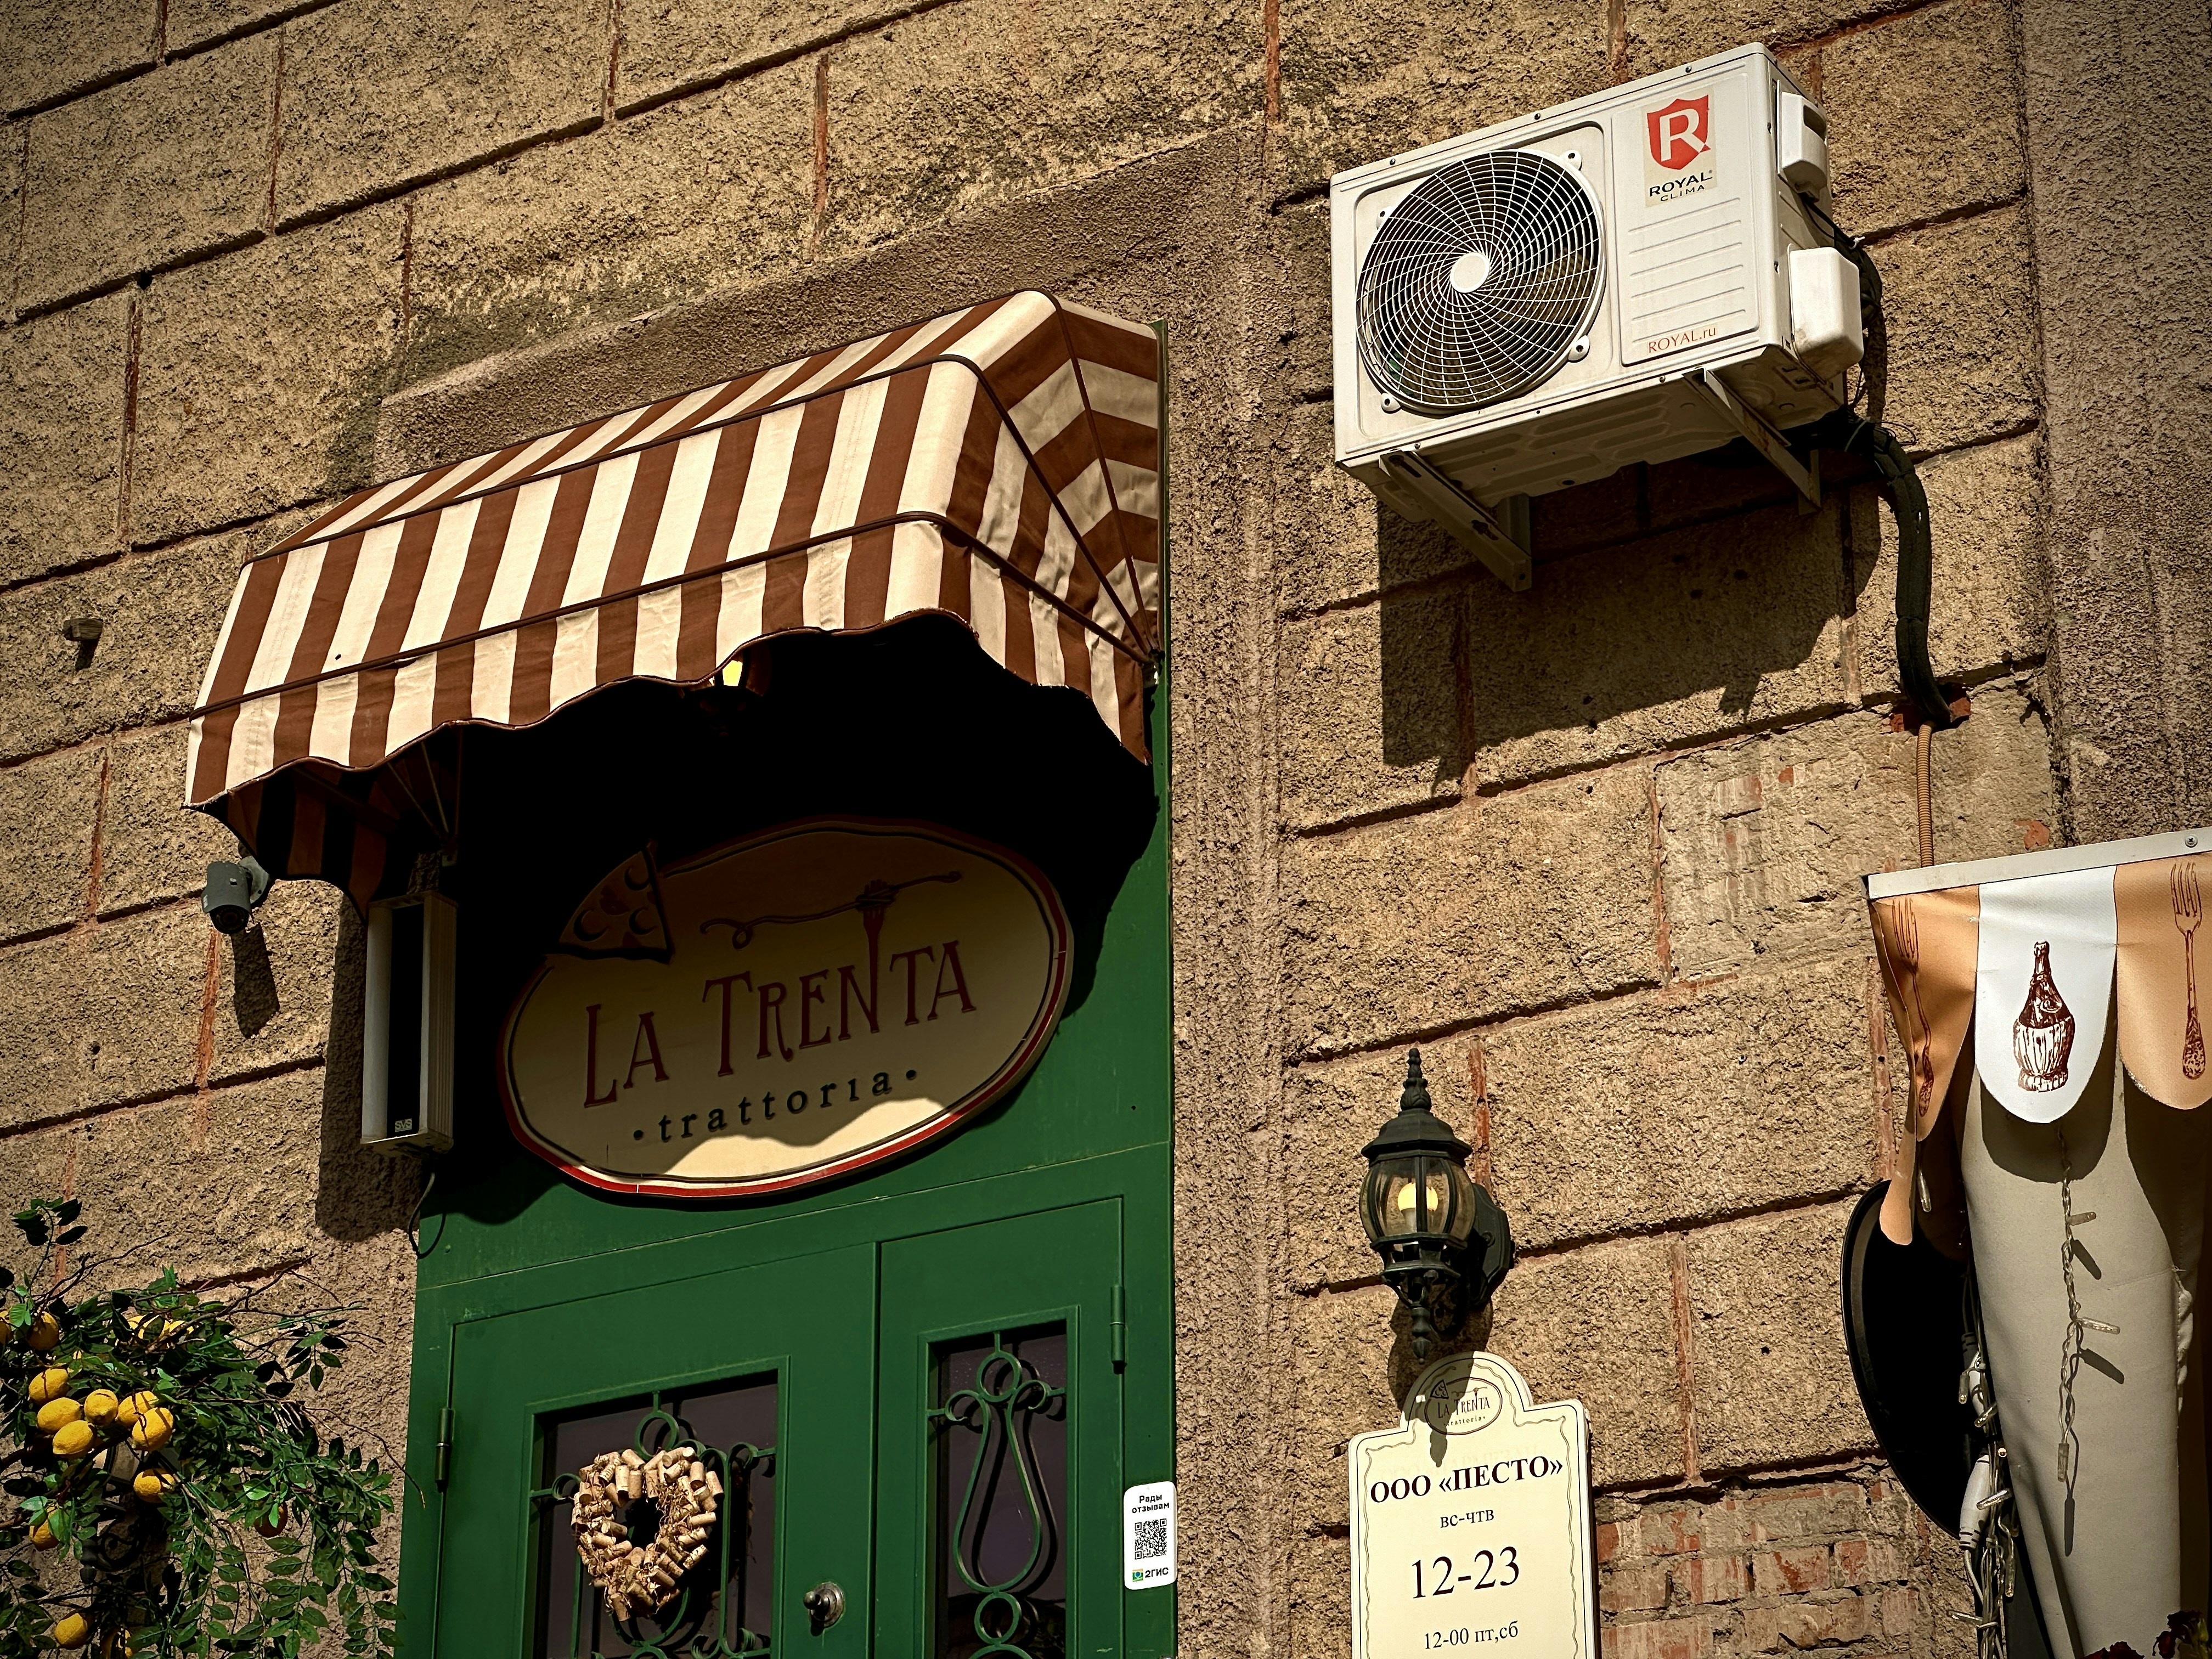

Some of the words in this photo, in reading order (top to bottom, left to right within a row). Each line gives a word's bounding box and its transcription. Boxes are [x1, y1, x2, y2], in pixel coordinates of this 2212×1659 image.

[1649, 172, 1713, 197] ROYAL
[1660, 184, 1705, 201] CLIMA
[1649, 328, 1716, 353] ROYAL.ru
[583, 1003, 670, 1109] LA
[702, 906, 978, 1079] TRENTA
[1437, 1402, 1449, 1419] LA
[1454, 1392, 1491, 1415] TRENTA
[1370, 1474, 1431, 1504] ООО
[1438, 1455, 1563, 1492] «ПЕСТО»
[1132, 1502, 1170, 1514] отзывам
[1139, 1494, 1163, 1504] Рады
[1440, 1509, 1494, 1528] вс-чтв
[1145, 1567, 1169, 1578] 2ГИС
[1411, 1545, 1520, 1599] 12-23
[1424, 1627, 1469, 1650] 12-00
[1475, 1620, 1519, 1645] пт,сб
